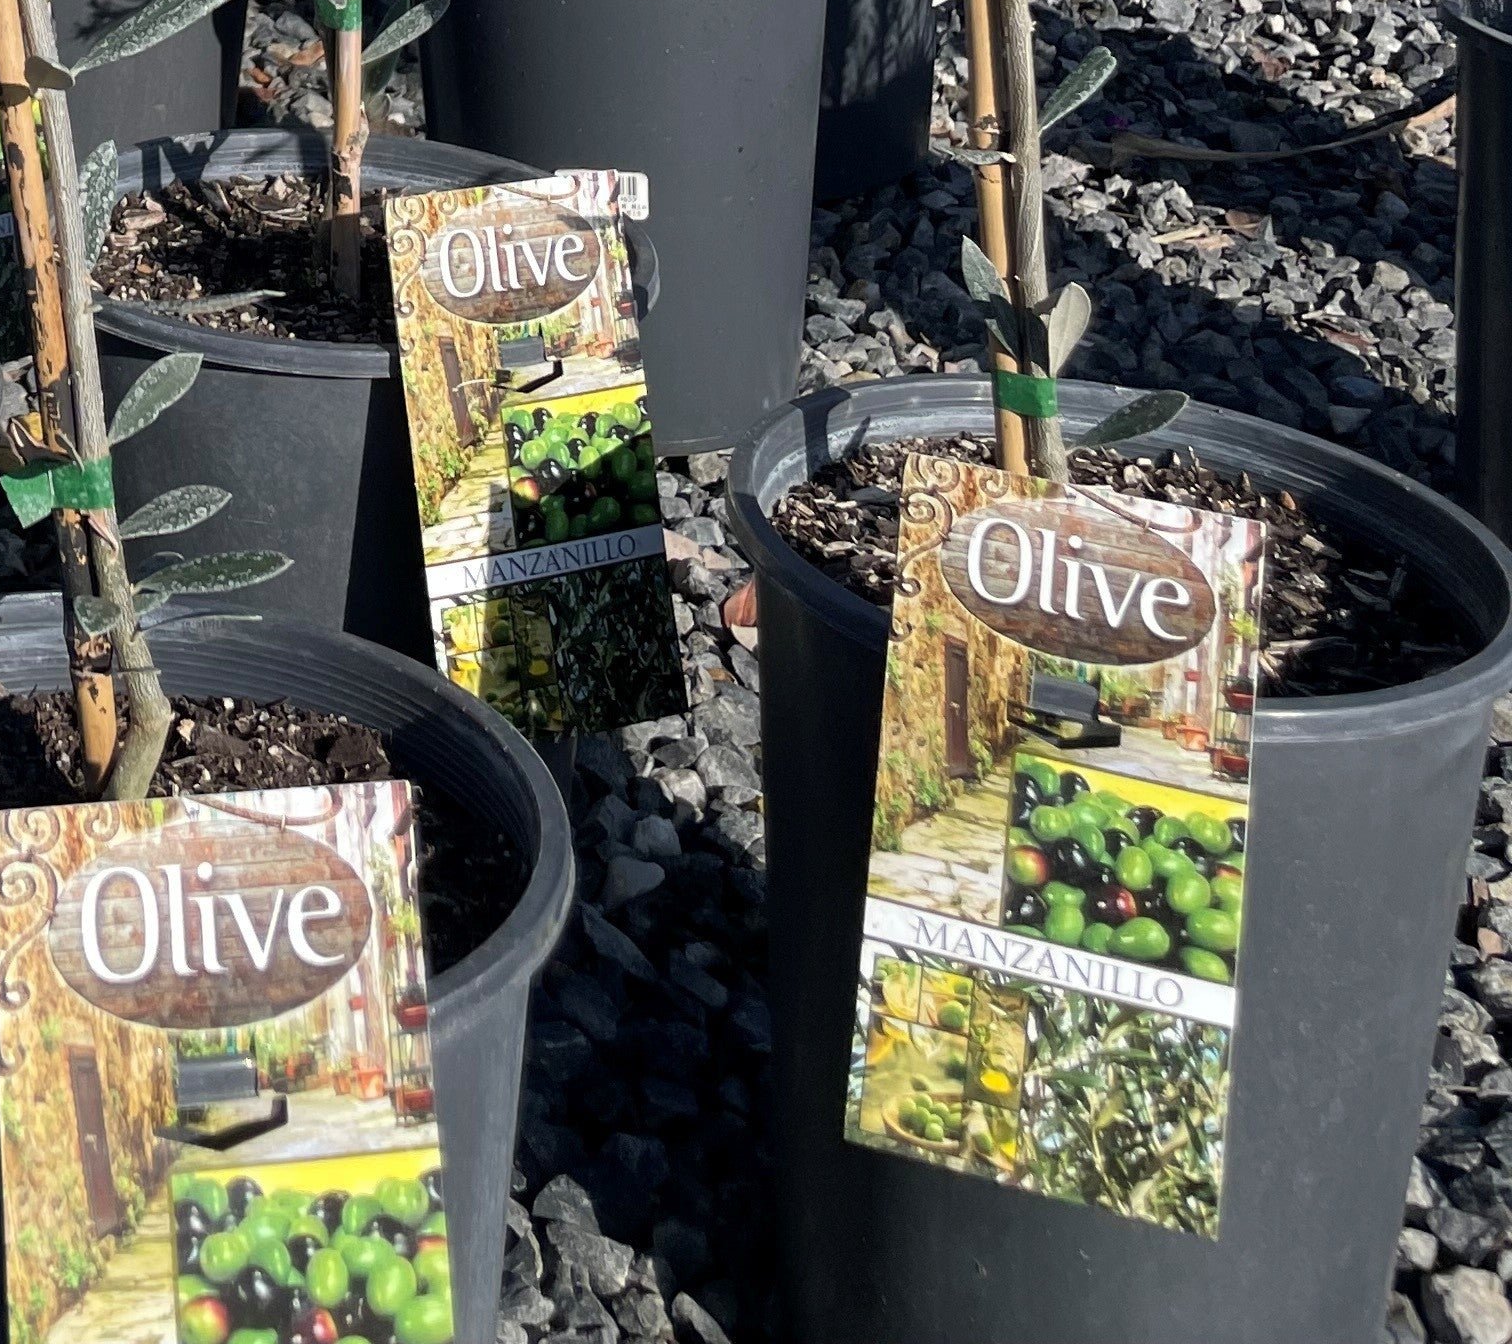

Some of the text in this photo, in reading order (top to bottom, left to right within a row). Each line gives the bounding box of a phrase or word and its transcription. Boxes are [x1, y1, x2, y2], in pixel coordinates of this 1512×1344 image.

[439, 223, 589, 300] Olive
[463, 533, 636, 588] MANZANILLO
[967, 516, 1195, 641] Olive
[80, 860, 346, 985] Olive
[908, 914, 1185, 1007] MANZANILLO
